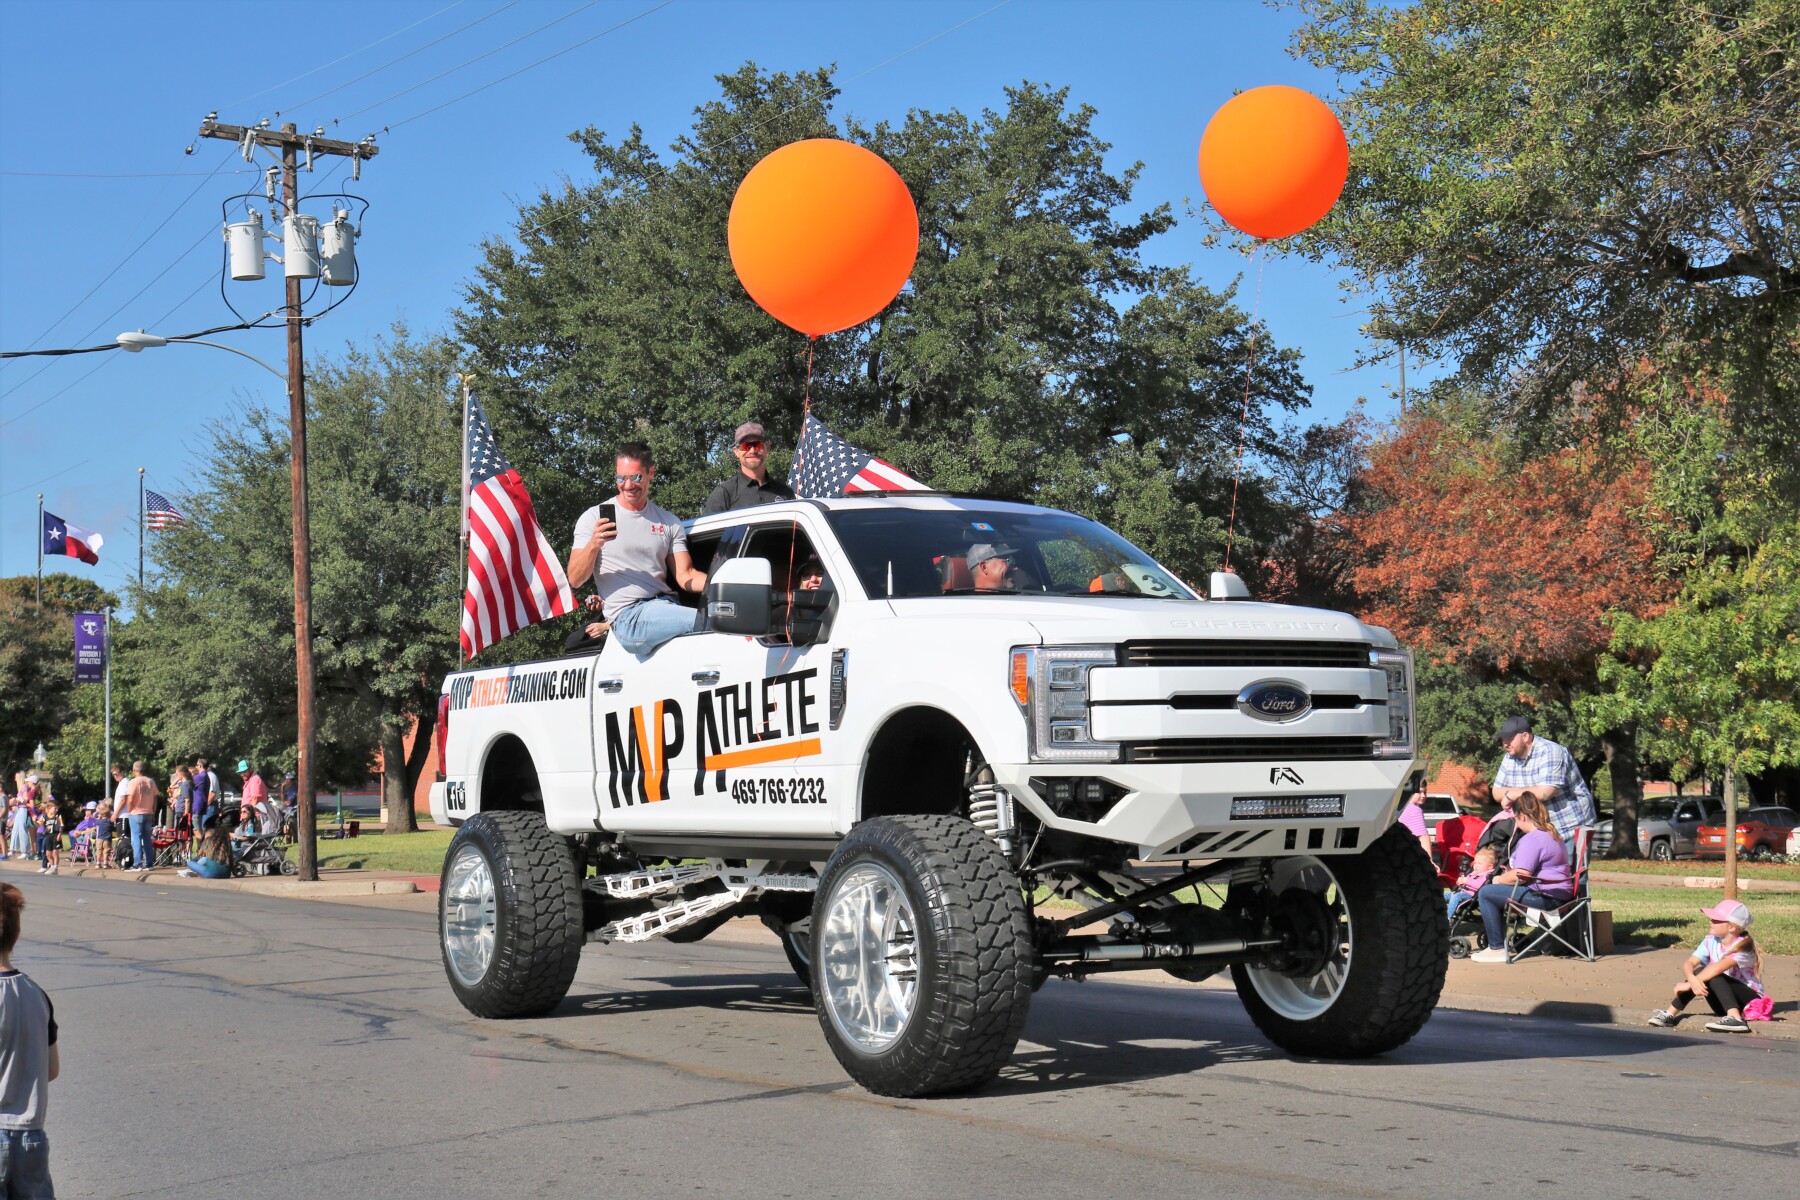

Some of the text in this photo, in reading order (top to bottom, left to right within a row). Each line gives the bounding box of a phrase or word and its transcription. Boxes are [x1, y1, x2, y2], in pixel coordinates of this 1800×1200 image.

[1170, 619, 1341, 633] SUPER DUTY
[449, 667, 588, 711] MVPATHLETETRAINING.COM
[1261, 693, 1296, 711] Ford
[605, 667, 820, 809] MVP ATHLETE
[732, 777, 828, 804] 469-766-2232
